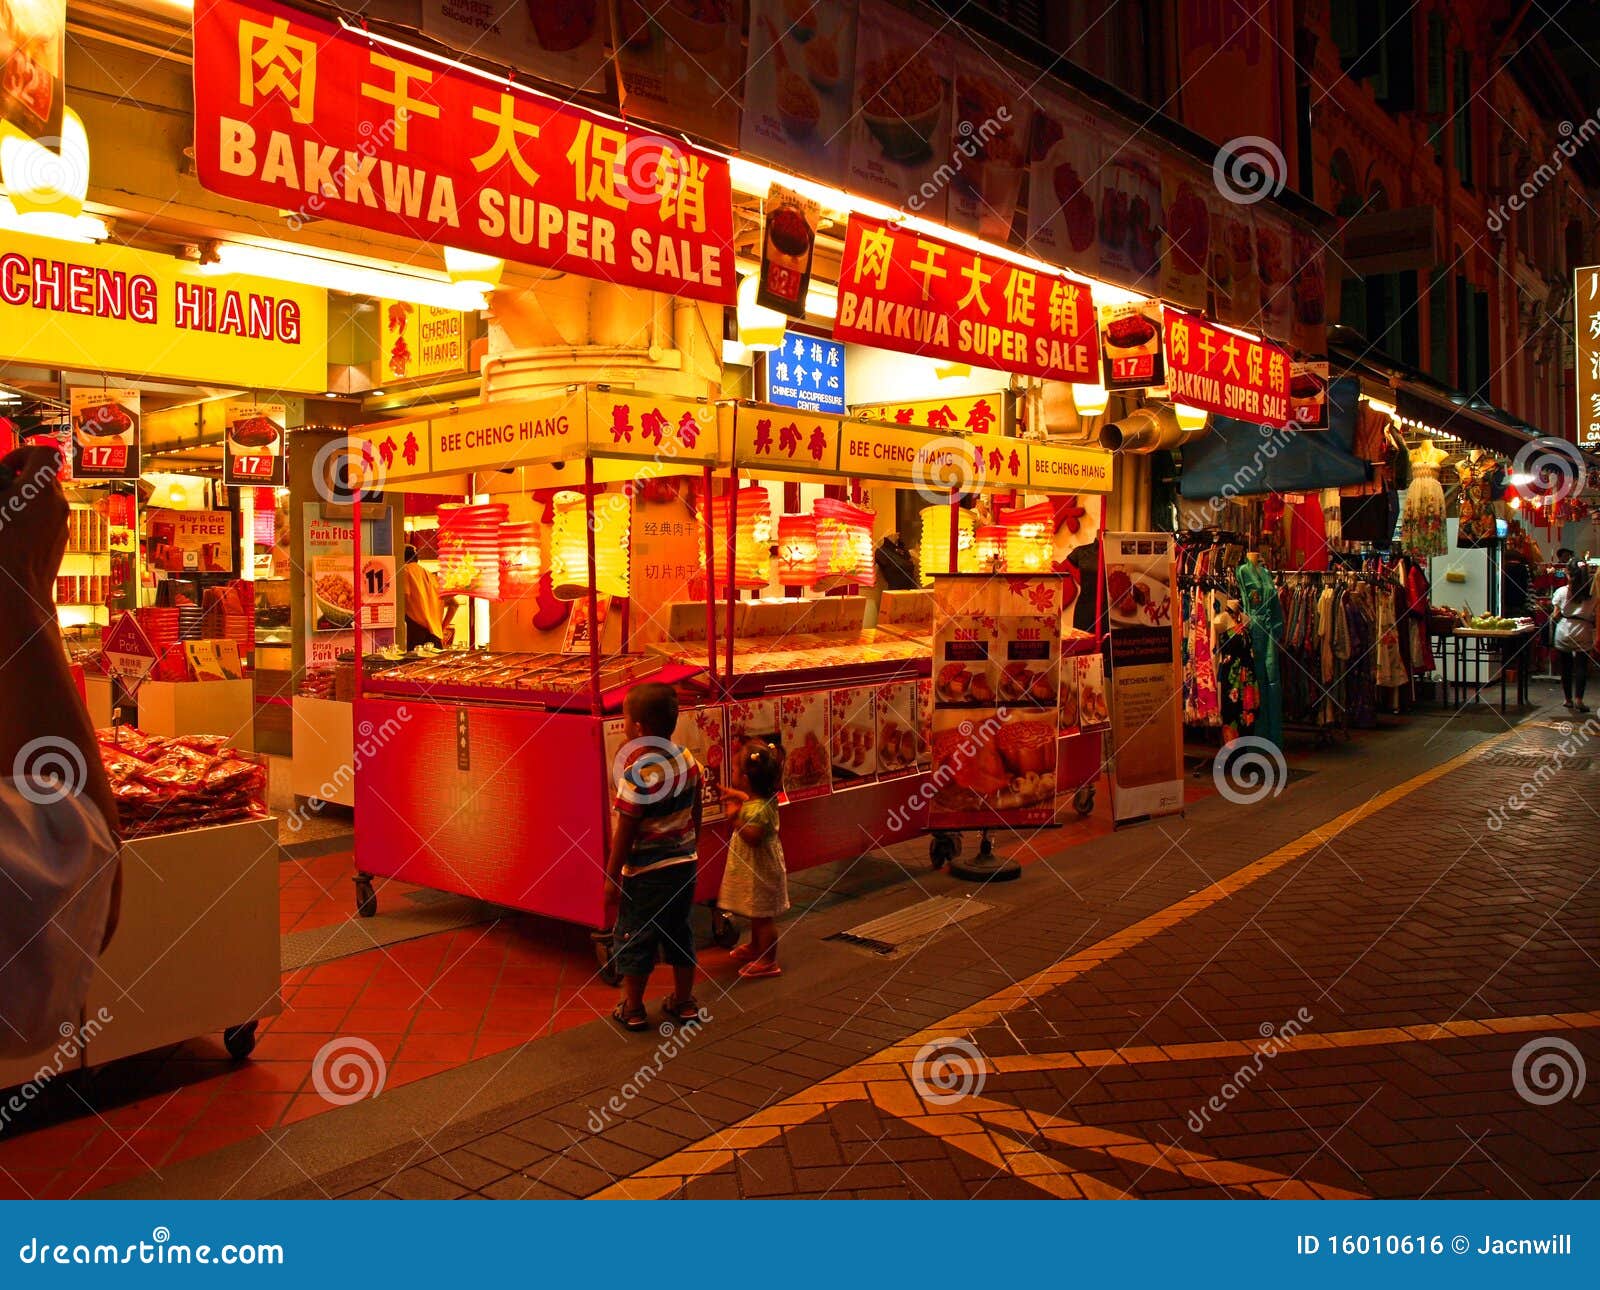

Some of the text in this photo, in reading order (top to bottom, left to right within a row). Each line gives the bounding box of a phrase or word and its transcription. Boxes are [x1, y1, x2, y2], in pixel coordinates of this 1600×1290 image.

[238, 16, 710, 234] 肉干大促销
[219, 116, 722, 287] BAKKWA SUPER SALE
[853, 227, 1080, 338] 肉干大促销
[0, 253, 300, 344] CHENG HIANG
[422, 317, 459, 342] CHENG
[840, 291, 1089, 373] BAKKWA SUPER SALE
[423, 341, 458, 362] HIANG
[1170, 319, 1286, 394] 肉干大促销
[1117, 358, 1139, 377] 17
[772, 384, 843, 406] CHINESE ACCUPRESSURE
[1169, 366, 1287, 421] BAKKWA SUPER SALE
[796, 400, 821, 412] CENTRE
[441, 415, 569, 453] BEE CHENG HIANG
[88, 447, 112, 466] 17
[849, 440, 953, 466] BEE CHENG HIANG
[239, 456, 260, 474] 17
[1035, 459, 1105, 479] BEE CHENG HIANG
[179, 514, 196, 524] Buy
[208, 514, 225, 523] Get
[180, 524, 225, 535] 1 FREE
[332, 527, 355, 541] Flos
[644, 522, 695, 537] 经典肉干
[645, 564, 697, 580] 切片肉干
[954, 628, 979, 640] SALE
[1016, 628, 1041, 640] SALE
[119, 639, 140, 653] Pork
